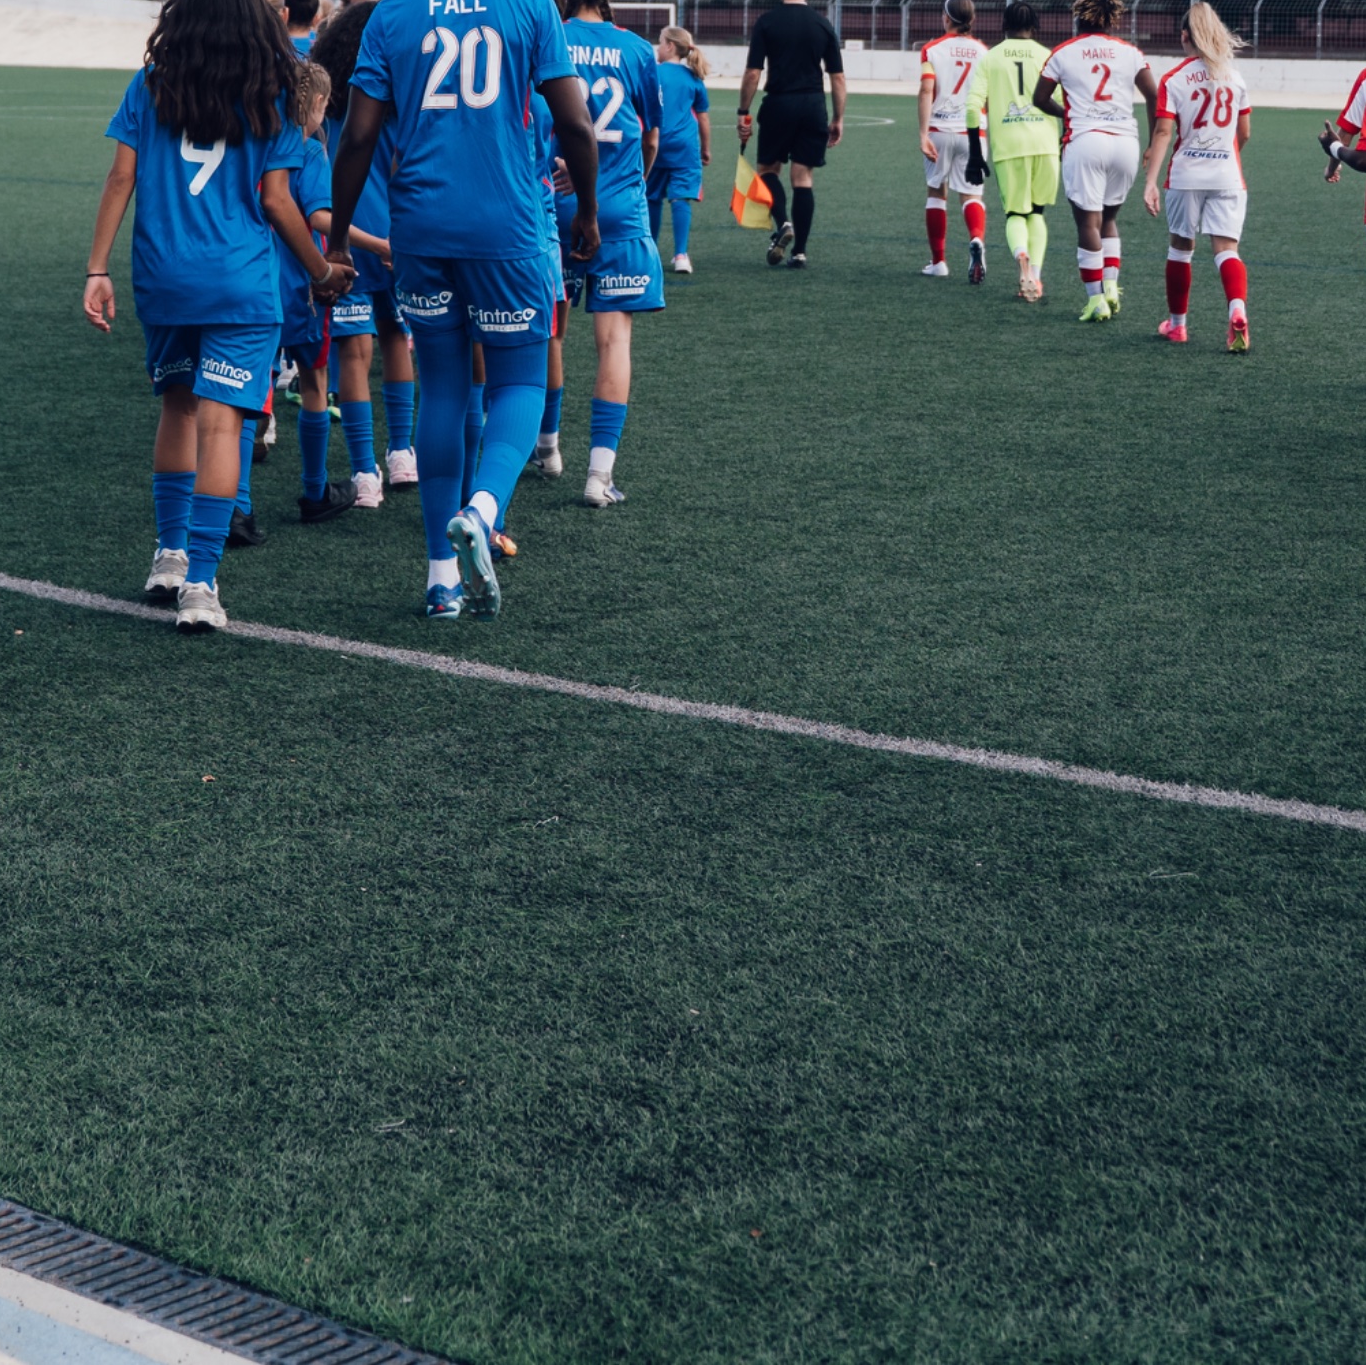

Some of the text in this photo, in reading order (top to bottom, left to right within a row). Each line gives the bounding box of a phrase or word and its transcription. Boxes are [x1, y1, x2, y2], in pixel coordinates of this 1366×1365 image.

[421, 25, 503, 111] 20
[950, 46, 977, 59] LEGER
[1004, 48, 1035, 59] BASIL
[951, 60, 972, 95] 7
[1013, 61, 1024, 96] 1
[1091, 62, 1113, 102] 2
[1190, 85, 1234, 130] 28
